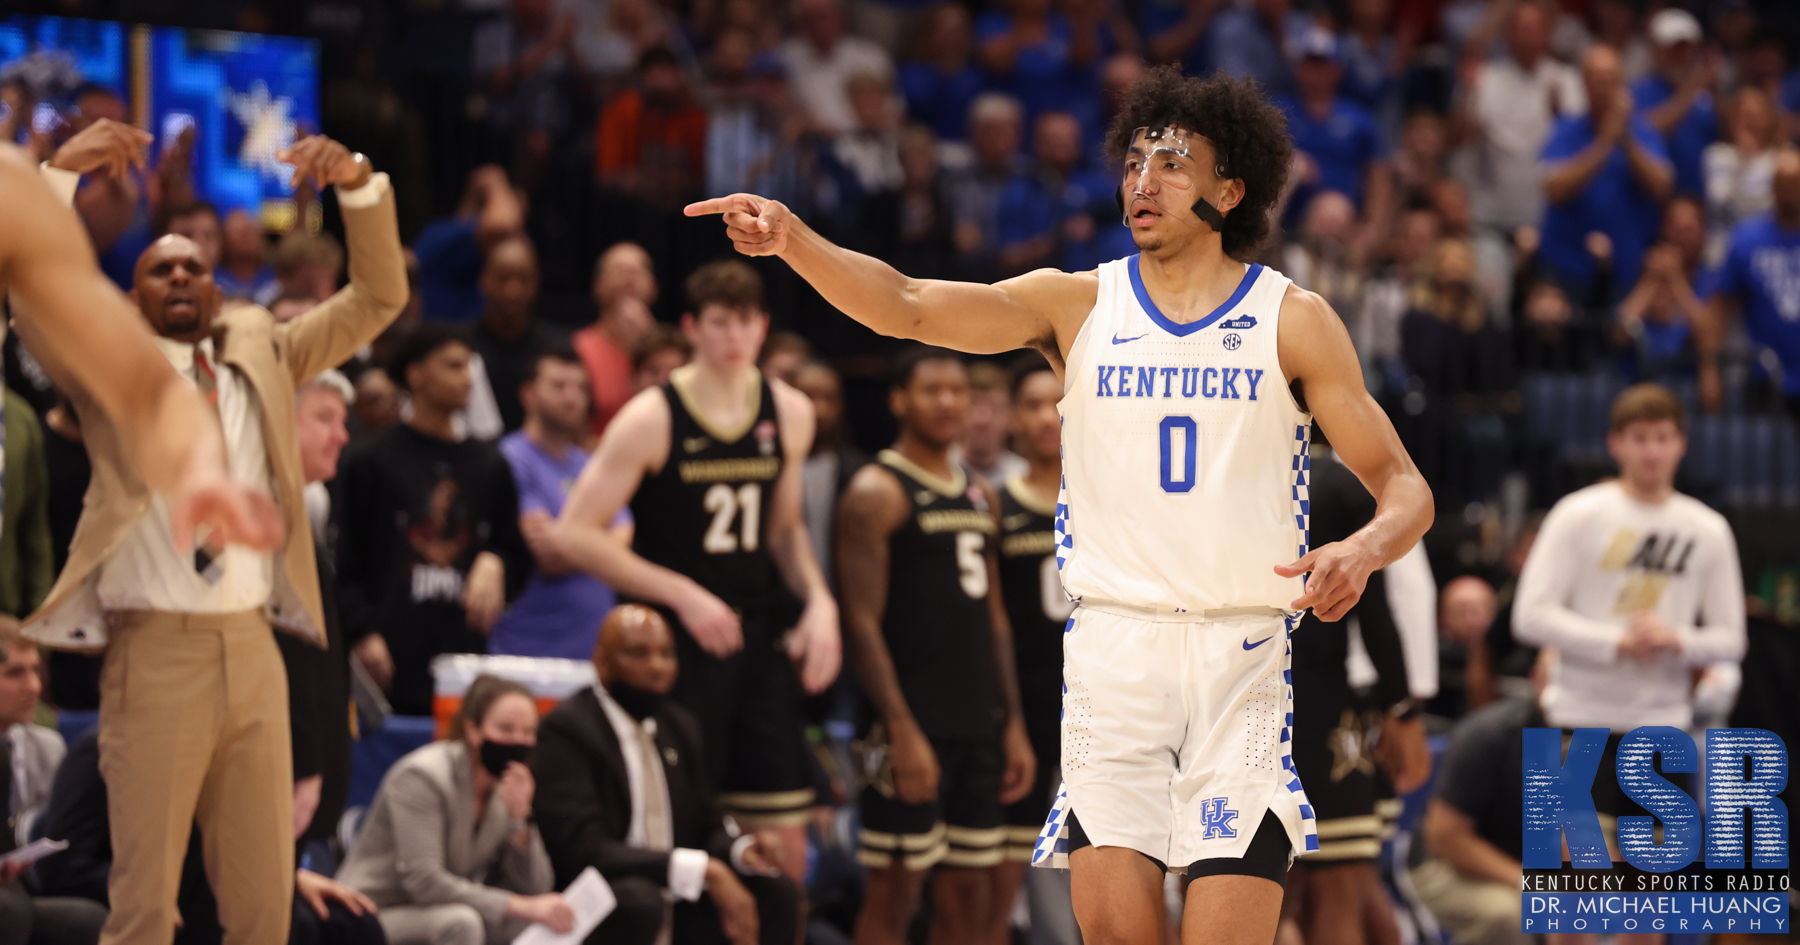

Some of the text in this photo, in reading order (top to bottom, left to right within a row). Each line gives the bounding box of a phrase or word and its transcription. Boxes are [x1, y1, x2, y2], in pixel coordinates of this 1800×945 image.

[1223, 333, 1241, 350] SEC
[1096, 365, 1264, 401] KENTUCKY
[1158, 414, 1198, 494] 0
[703, 482, 762, 554] 21
[956, 531, 989, 599] 5
[1200, 797, 1239, 840] UK
